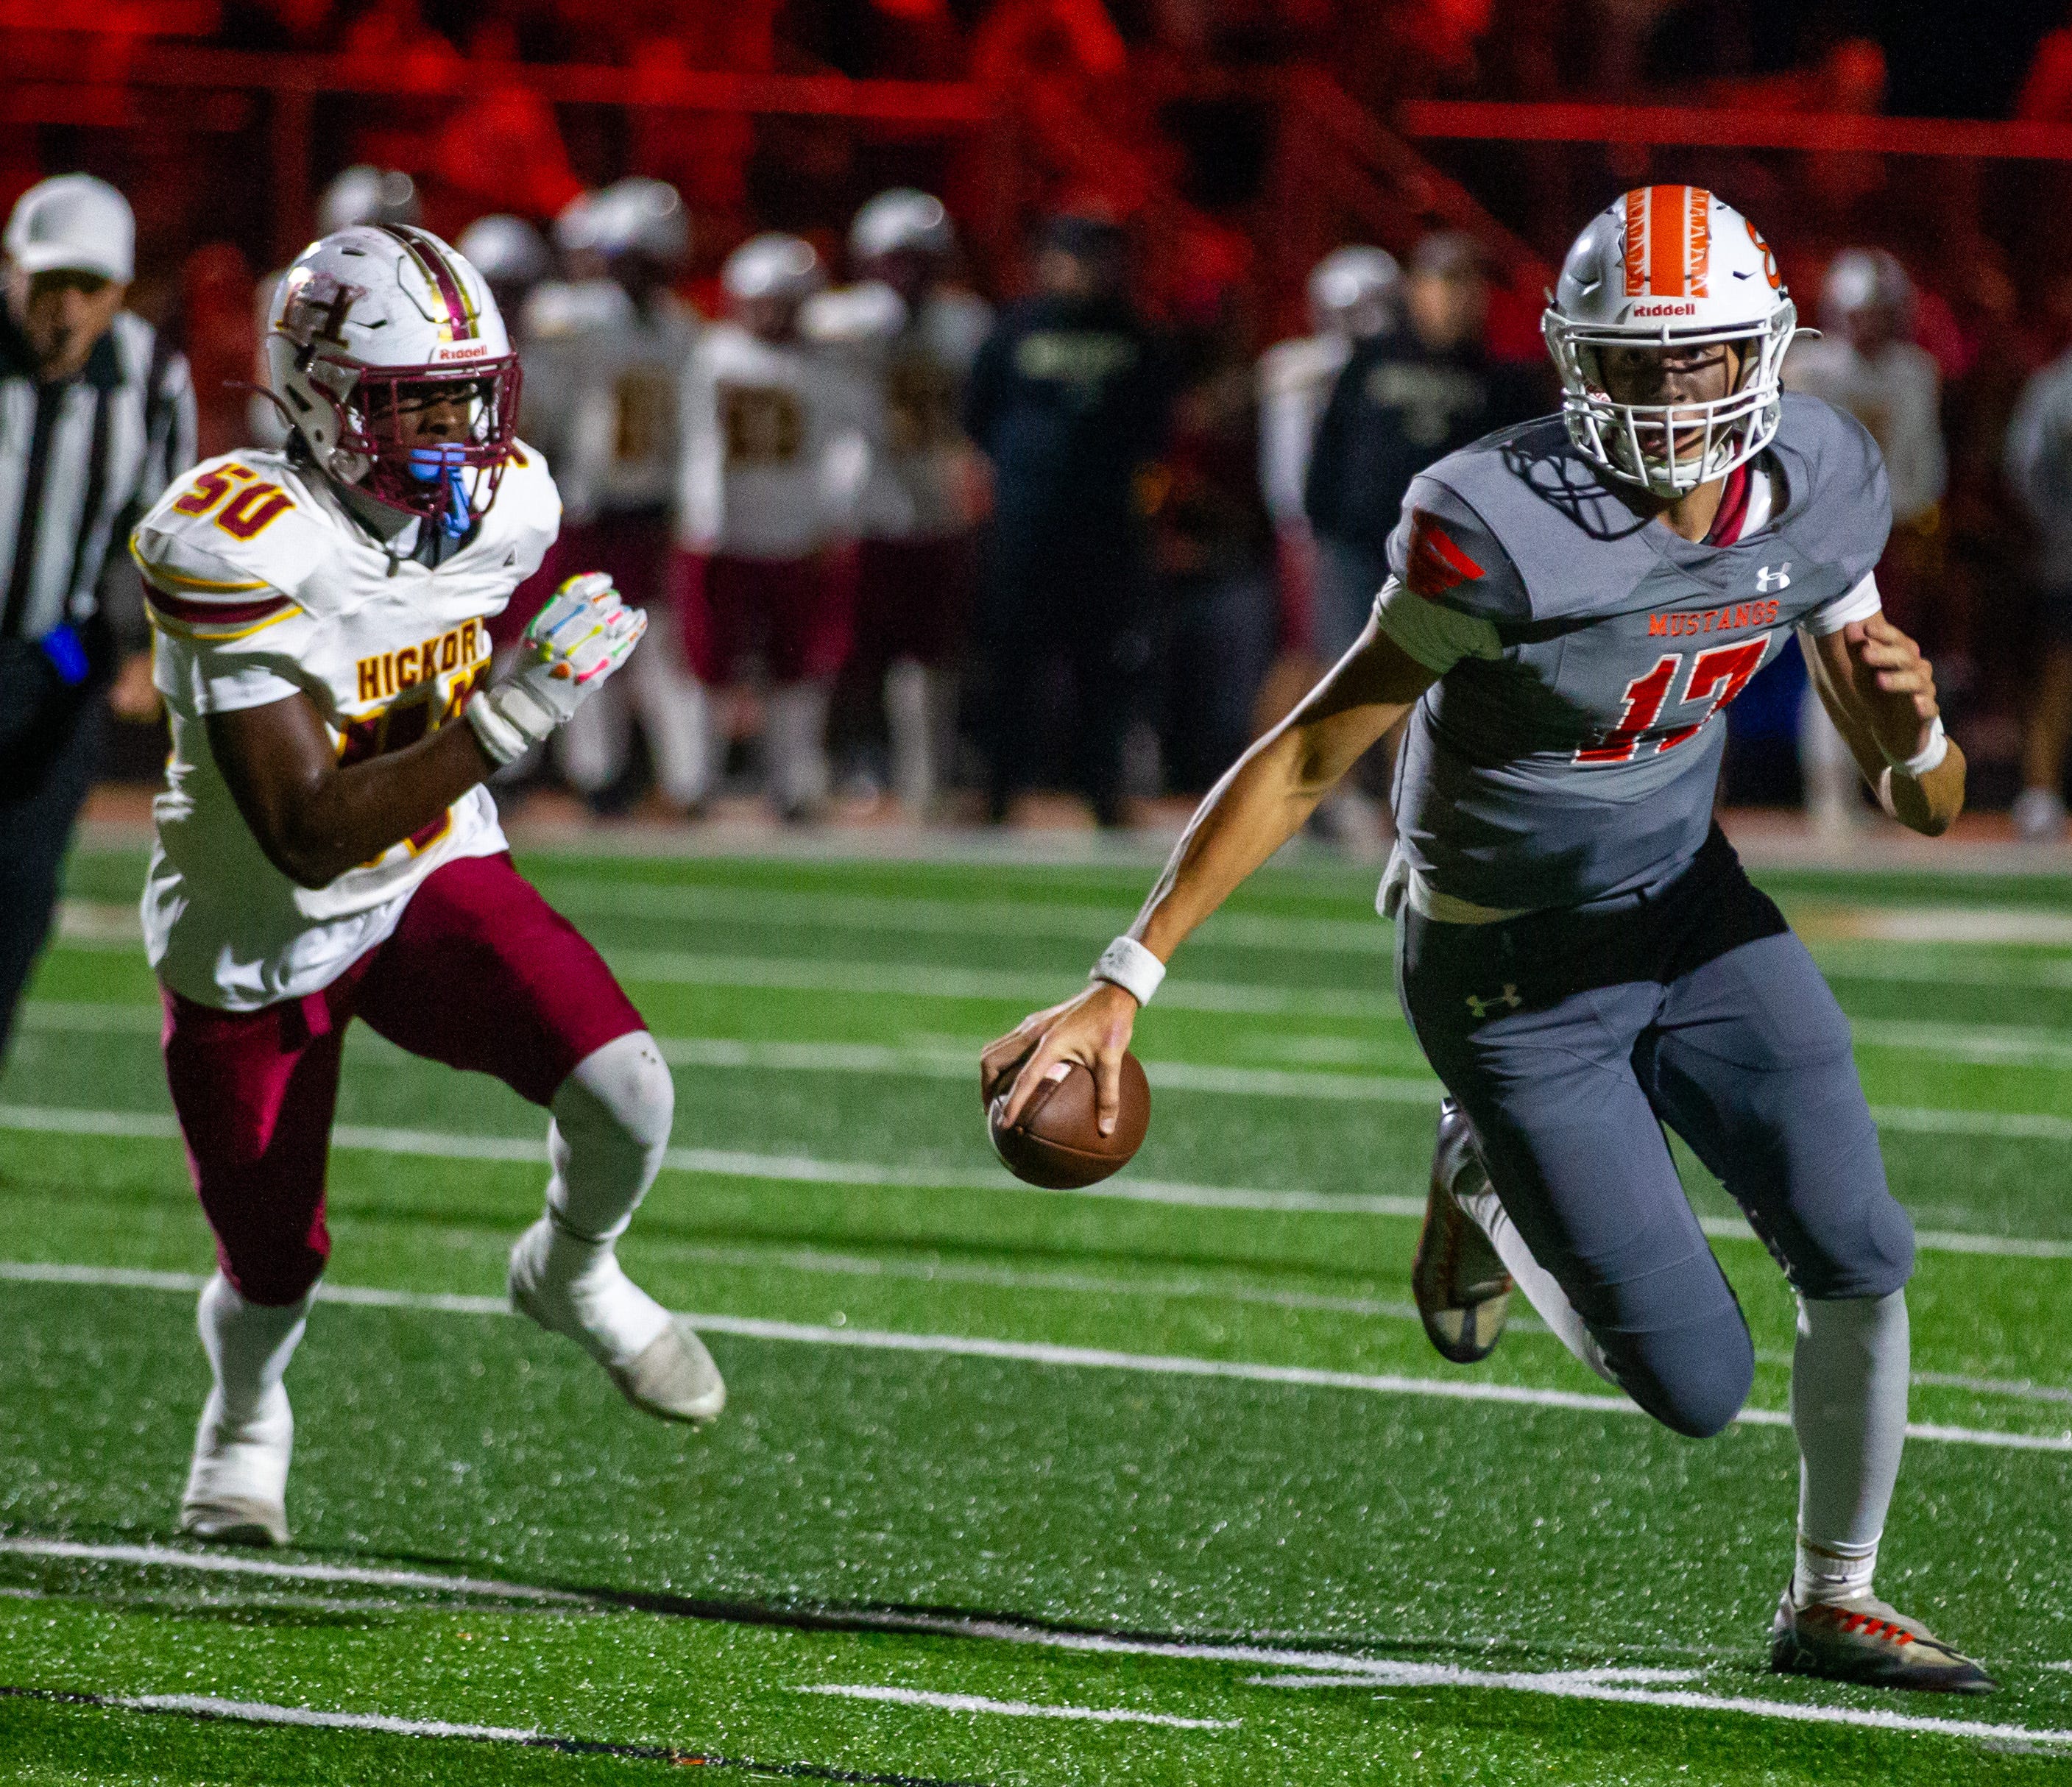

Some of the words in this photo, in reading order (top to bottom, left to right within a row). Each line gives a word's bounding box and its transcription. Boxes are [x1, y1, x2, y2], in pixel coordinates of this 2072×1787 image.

[1633, 302, 1696, 317] Riddell
[439, 344, 487, 360] Riddell
[174, 462, 296, 541] 50
[1647, 598, 1781, 637] MUSTANGS
[356, 615, 485, 703] HICKOR
[1571, 631, 1772, 764] 17
